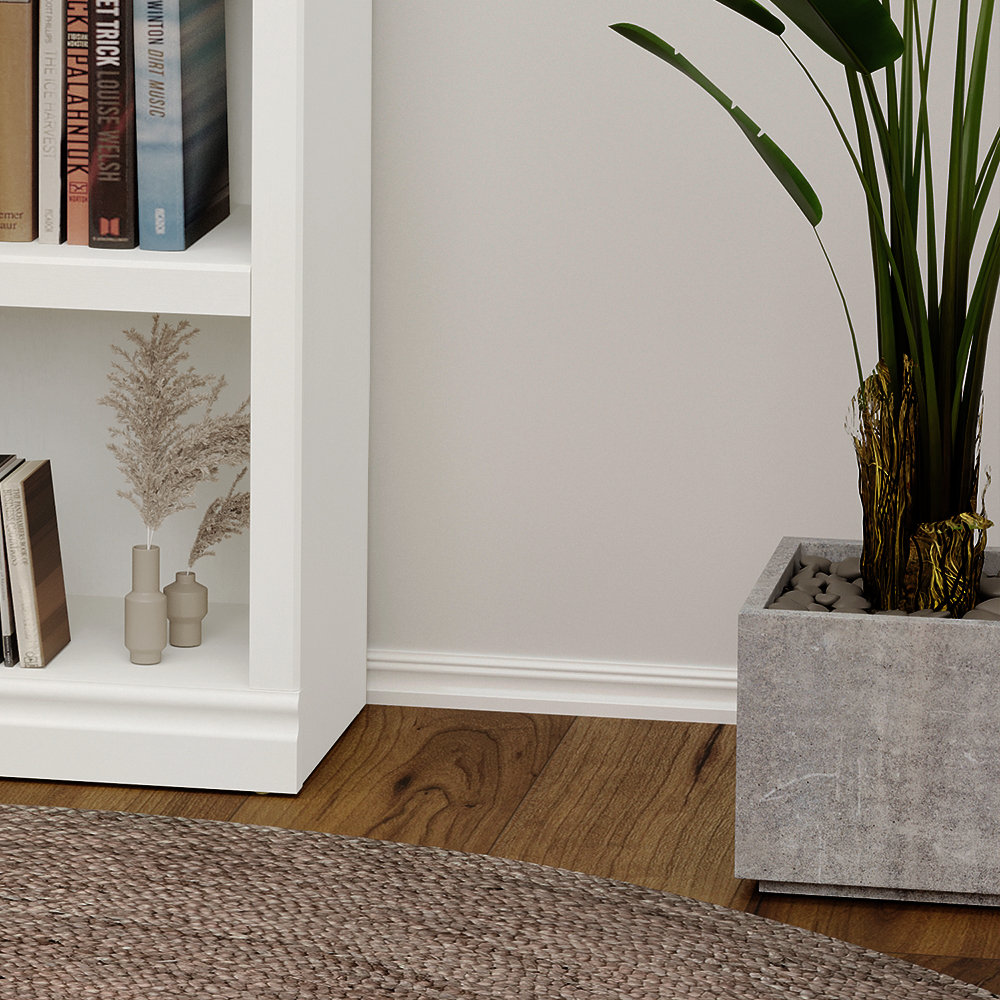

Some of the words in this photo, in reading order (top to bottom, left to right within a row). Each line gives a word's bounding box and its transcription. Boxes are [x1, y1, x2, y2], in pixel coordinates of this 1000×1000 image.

[96, 20, 120, 67] TRICK
[147, 0, 164, 45] WINTON
[147, 49, 164, 77] DIRT
[67, 55, 89, 175] PALAHNIUK
[96, 71, 121, 125] LOUISE
[149, 79, 165, 118] MUSIC
[97, 130, 121, 182] WELSH
